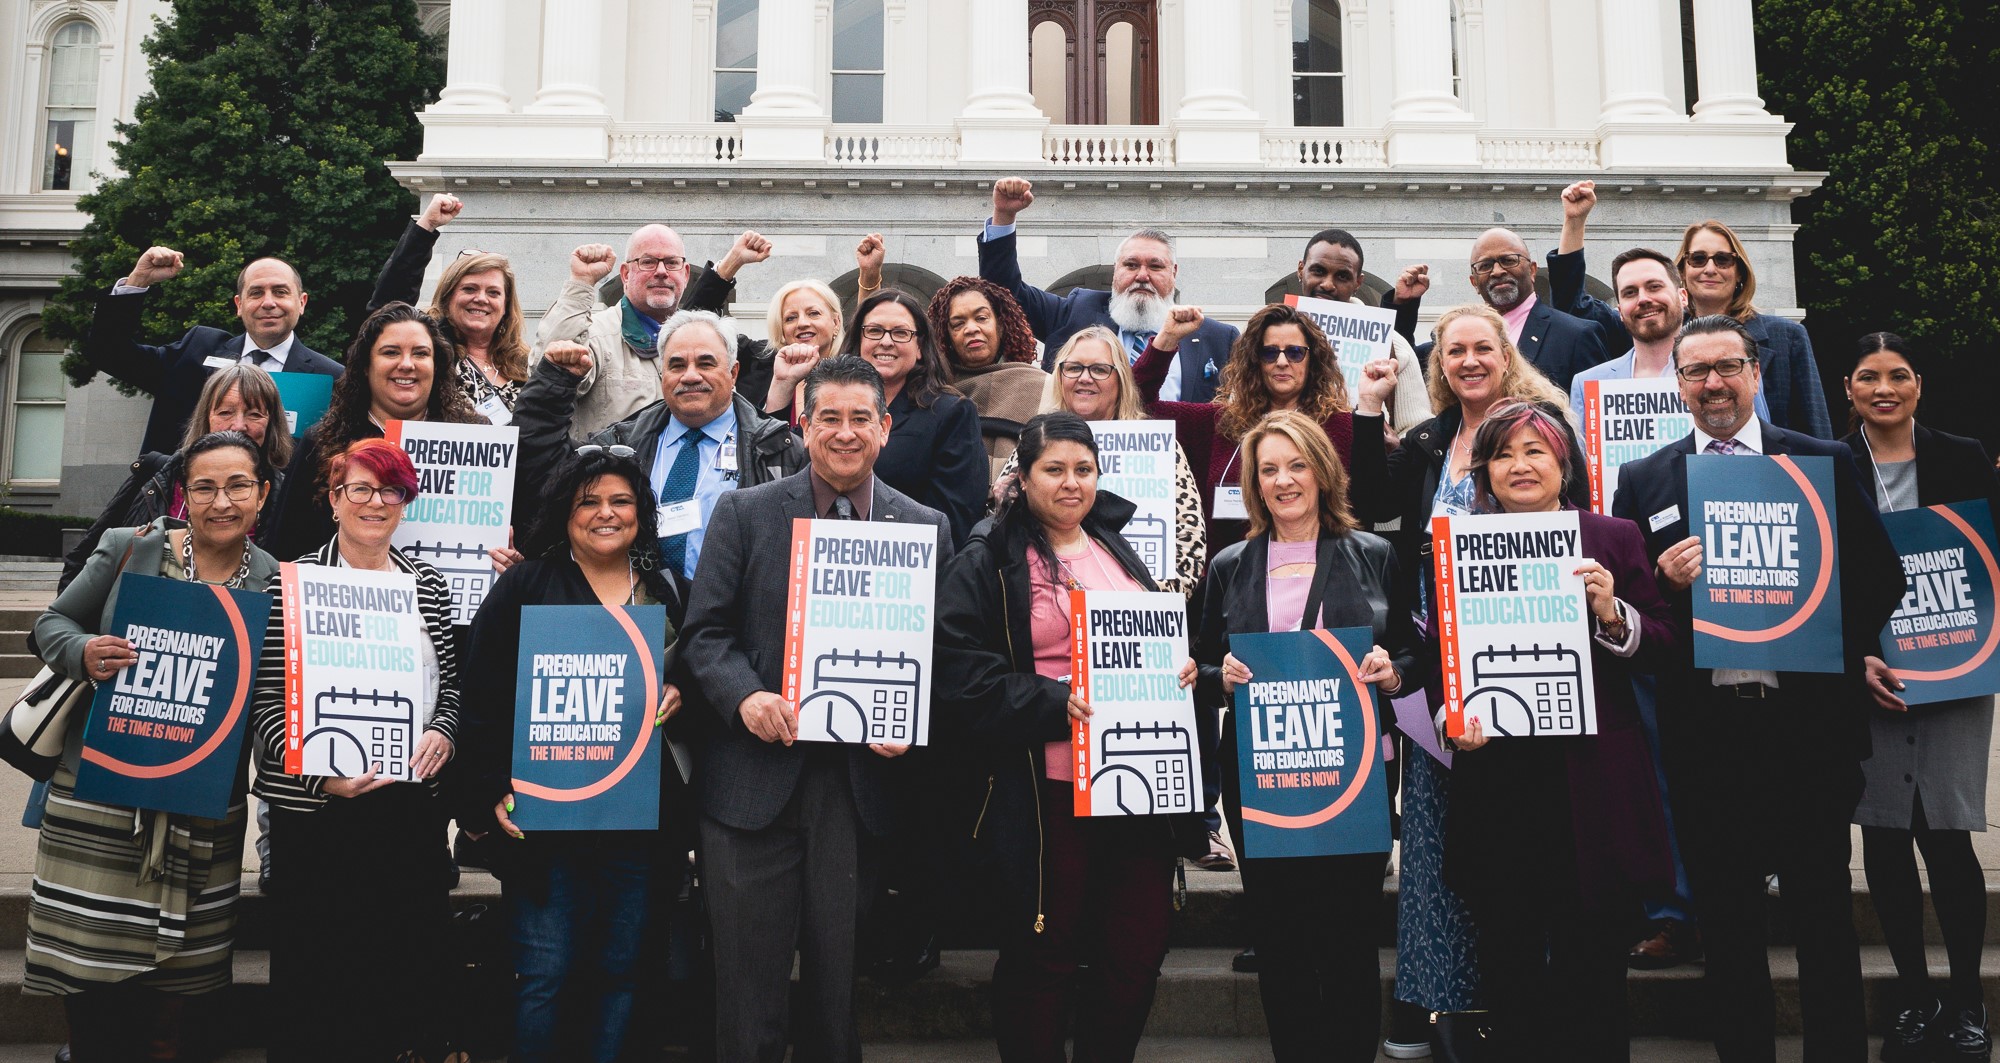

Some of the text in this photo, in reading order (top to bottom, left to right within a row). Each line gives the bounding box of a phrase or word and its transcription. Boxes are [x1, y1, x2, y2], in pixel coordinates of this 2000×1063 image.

[1342, 342, 1372, 366] FOR
[1604, 392, 1691, 416] PREGNAN
[1094, 432, 1172, 452] EGNANCY
[1604, 417, 1689, 441] LEAVE FOR
[404, 438, 514, 468] PREGNANCY
[1124, 454, 1156, 475] FOR
[414, 468, 492, 496] AVE FOR
[1593, 480, 1598, 500] IS
[403, 498, 504, 527] DUCATORS
[1704, 500, 1799, 524] PREGNANCY
[796, 540, 804, 579] THE
[814, 537, 933, 569] PREGNANCY
[1456, 529, 1576, 562] PREGNANCY
[1705, 524, 1800, 568] LEAVE
[1900, 547, 1964, 576] GNANCY
[812, 568, 912, 600] LEAVE FOR
[1458, 562, 1560, 593] LEAVE FOR
[1707, 568, 1799, 587] FOR EDUCATORS
[304, 580, 414, 614] PREGNANCY
[792, 584, 801, 637] TIME
[1461, 594, 1579, 626] EDUCATORS
[1709, 588, 1794, 605] THE TIME IS NOW!
[305, 610, 399, 642] LEAVE FOR
[810, 600, 926, 632] EDUCATORS
[1090, 609, 1184, 638] PREGNANCY
[1438, 540, 1459, 713] THE TIME IS NOW
[1890, 609, 1978, 636] FOR EDUCATORS
[126, 624, 226, 660] PREGNANCY
[290, 624, 298, 674] TIME
[1896, 628, 1977, 652] THE TIME IS NOW!
[306, 639, 415, 672] EDUCATORS
[532, 654, 628, 676] PREGNANCY
[789, 642, 797, 668] IS
[1092, 641, 1173, 670] LEAVE FOR
[114, 650, 218, 706] LEAVE
[292, 679, 298, 705] IS
[1076, 658, 1084, 699] TIM
[1248, 678, 1340, 706] PREGNANCY
[110, 694, 206, 726] FOR EDUCATORS
[530, 678, 624, 722] LEAVE
[108, 716, 195, 744] THE TIME IS NOW!
[290, 710, 300, 750] NOW
[529, 724, 622, 742] FOR EDUCATORS
[1078, 720, 1085, 745] IS
[1250, 702, 1344, 750] LEAVE
[530, 746, 614, 760] THE TIME IS NOW!
[1253, 748, 1344, 770] FOR EDUCATORS
[1078, 750, 1088, 792] NOW
[1256, 770, 1340, 788] THE TIME IS NOW!
